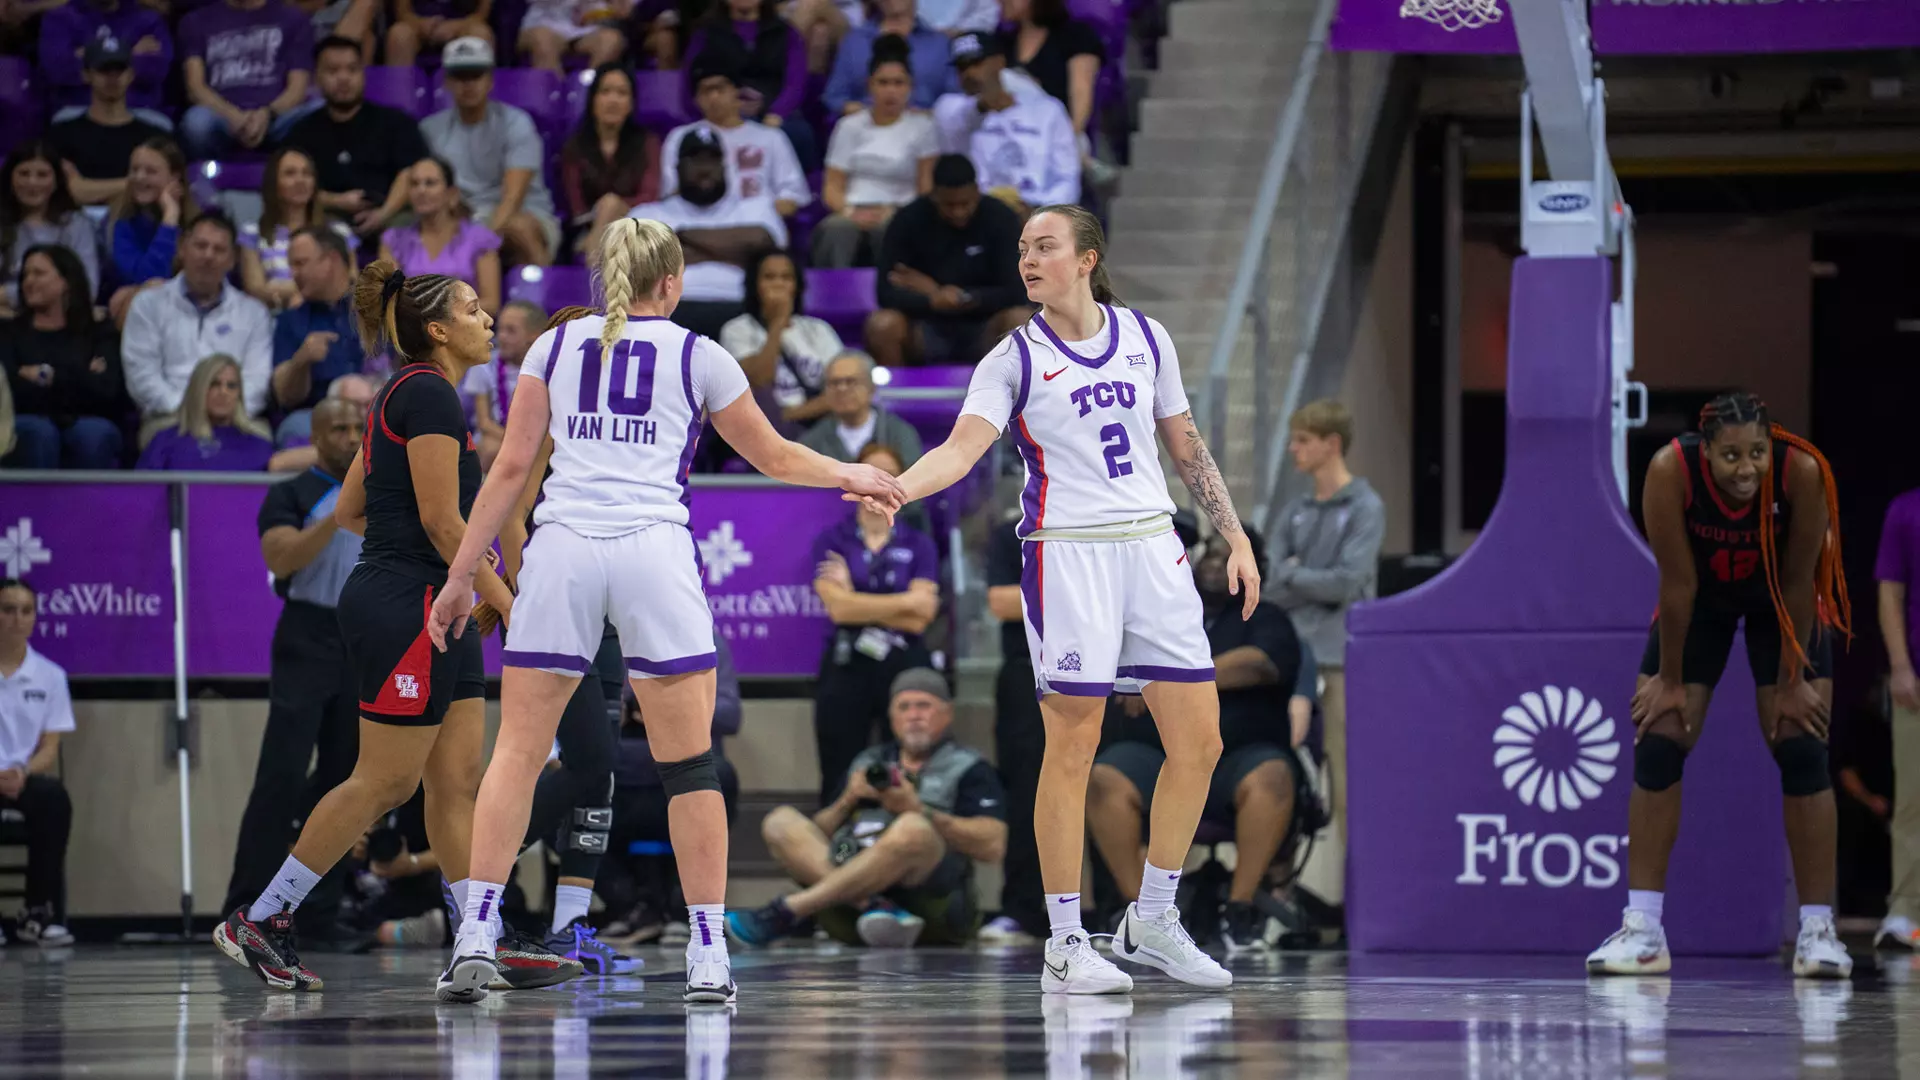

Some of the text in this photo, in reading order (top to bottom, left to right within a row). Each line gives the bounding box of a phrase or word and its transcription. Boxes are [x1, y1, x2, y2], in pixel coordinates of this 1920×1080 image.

[577, 338, 657, 416] 10
[1070, 381, 1136, 418] TCU
[568, 415, 656, 445] VAN LITH
[1100, 422, 1133, 479] 2
[36, 582, 161, 616] t&White
[1455, 813, 1630, 889] Fros
